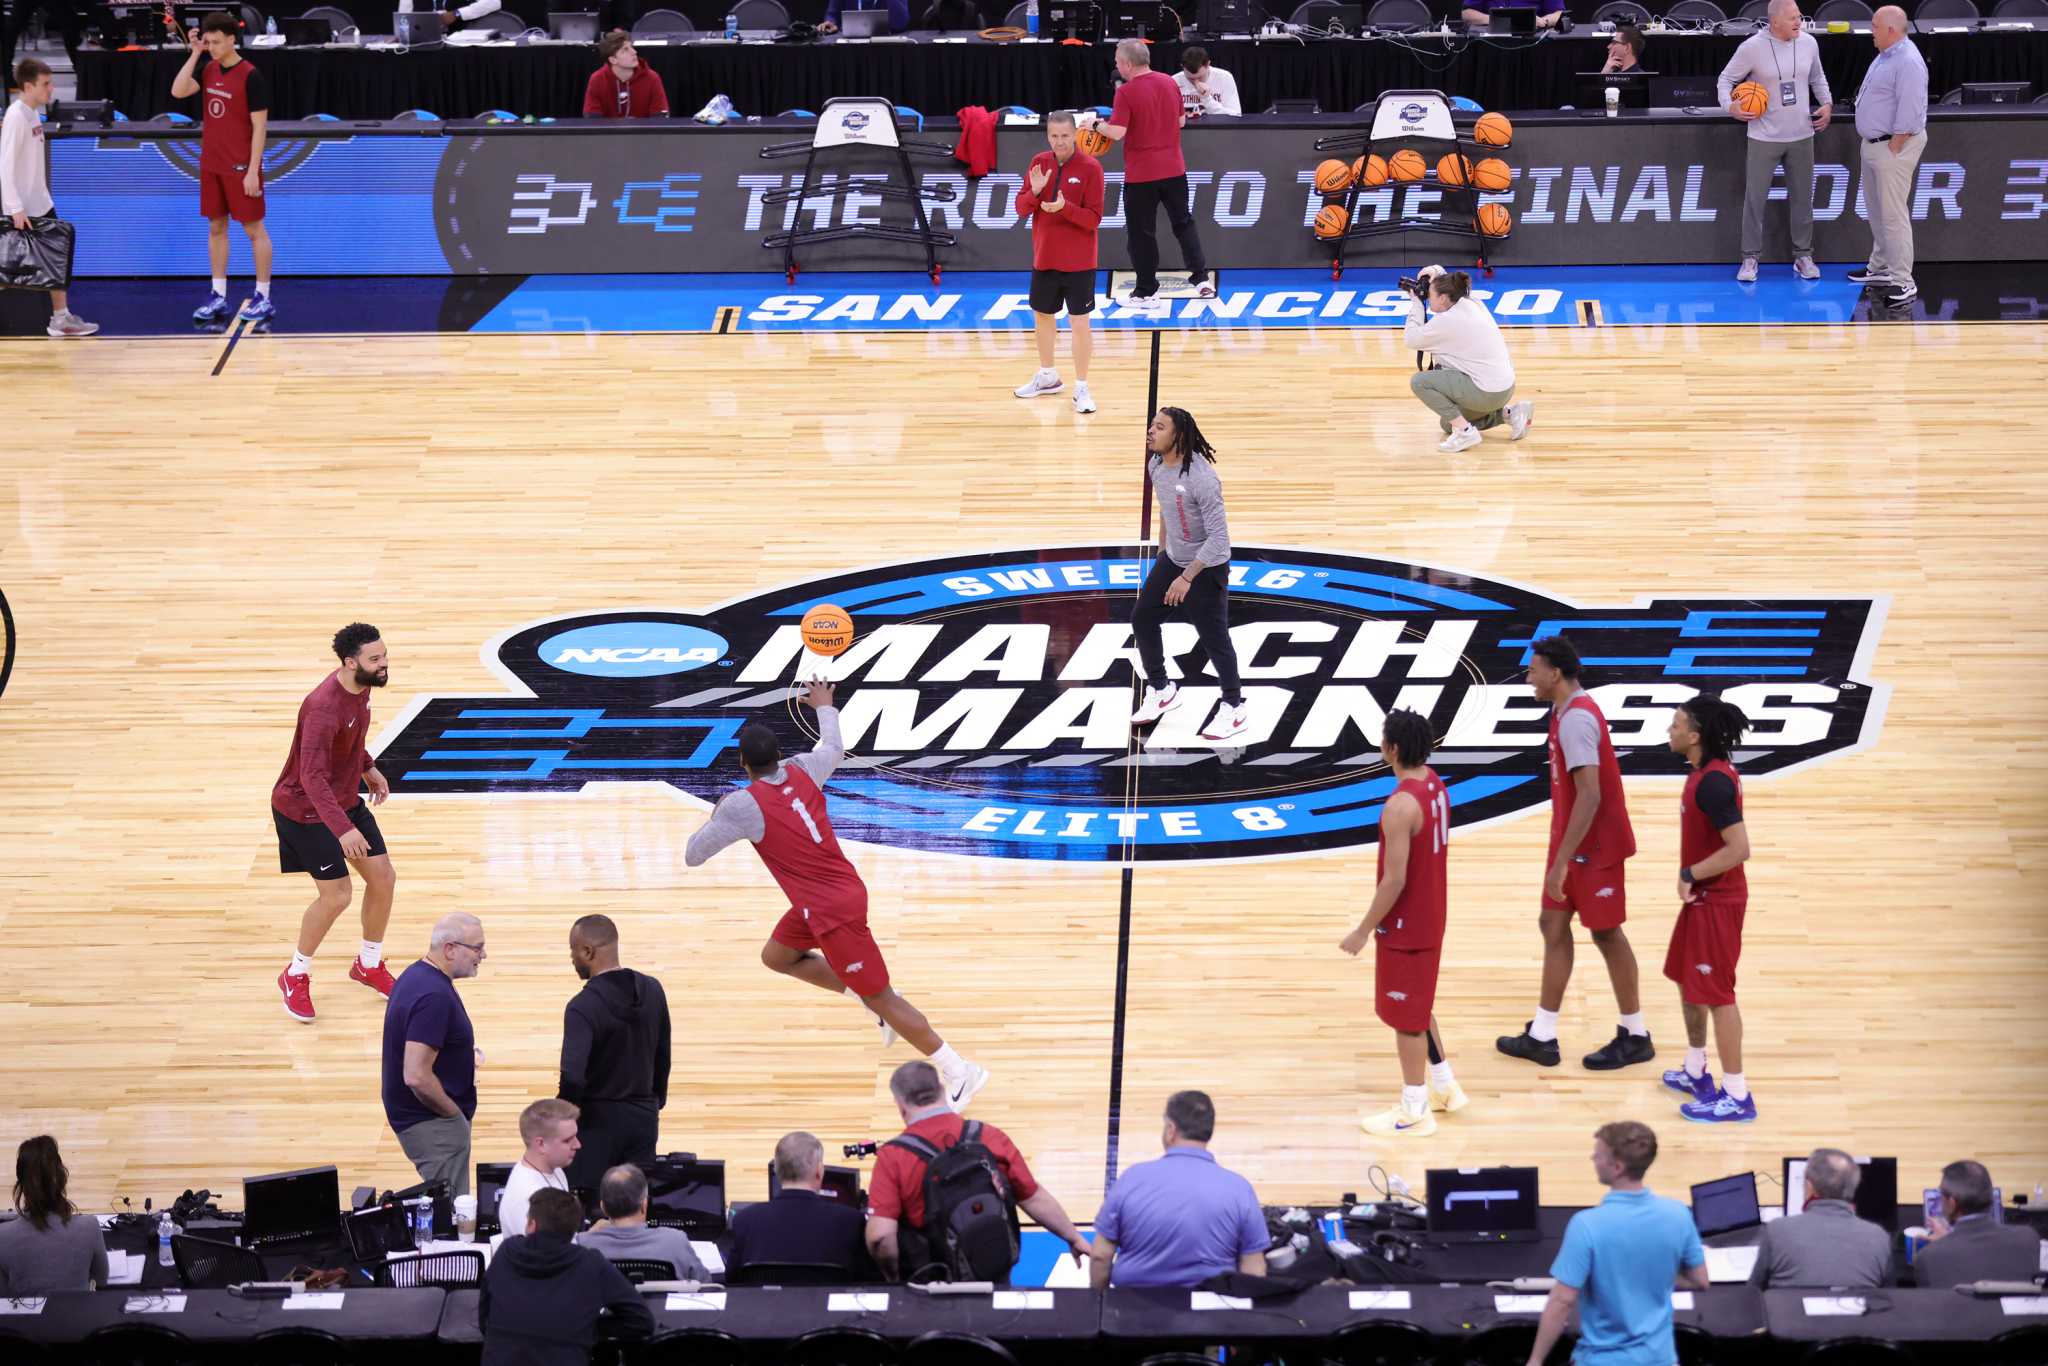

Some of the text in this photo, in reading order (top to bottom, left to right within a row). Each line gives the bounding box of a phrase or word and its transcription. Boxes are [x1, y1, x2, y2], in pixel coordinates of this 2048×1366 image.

[737, 174, 888, 230] THE
[747, 294, 963, 321] SAN
[942, 564, 1142, 597] SWEE
[553, 648, 718, 663] NCAA
[735, 620, 1478, 683] MARCH
[809, 636, 844, 648] Wilson
[812, 682, 1840, 750] MADNESS
[791, 797, 823, 844] 1
[961, 806, 1288, 838] ELITE 8
